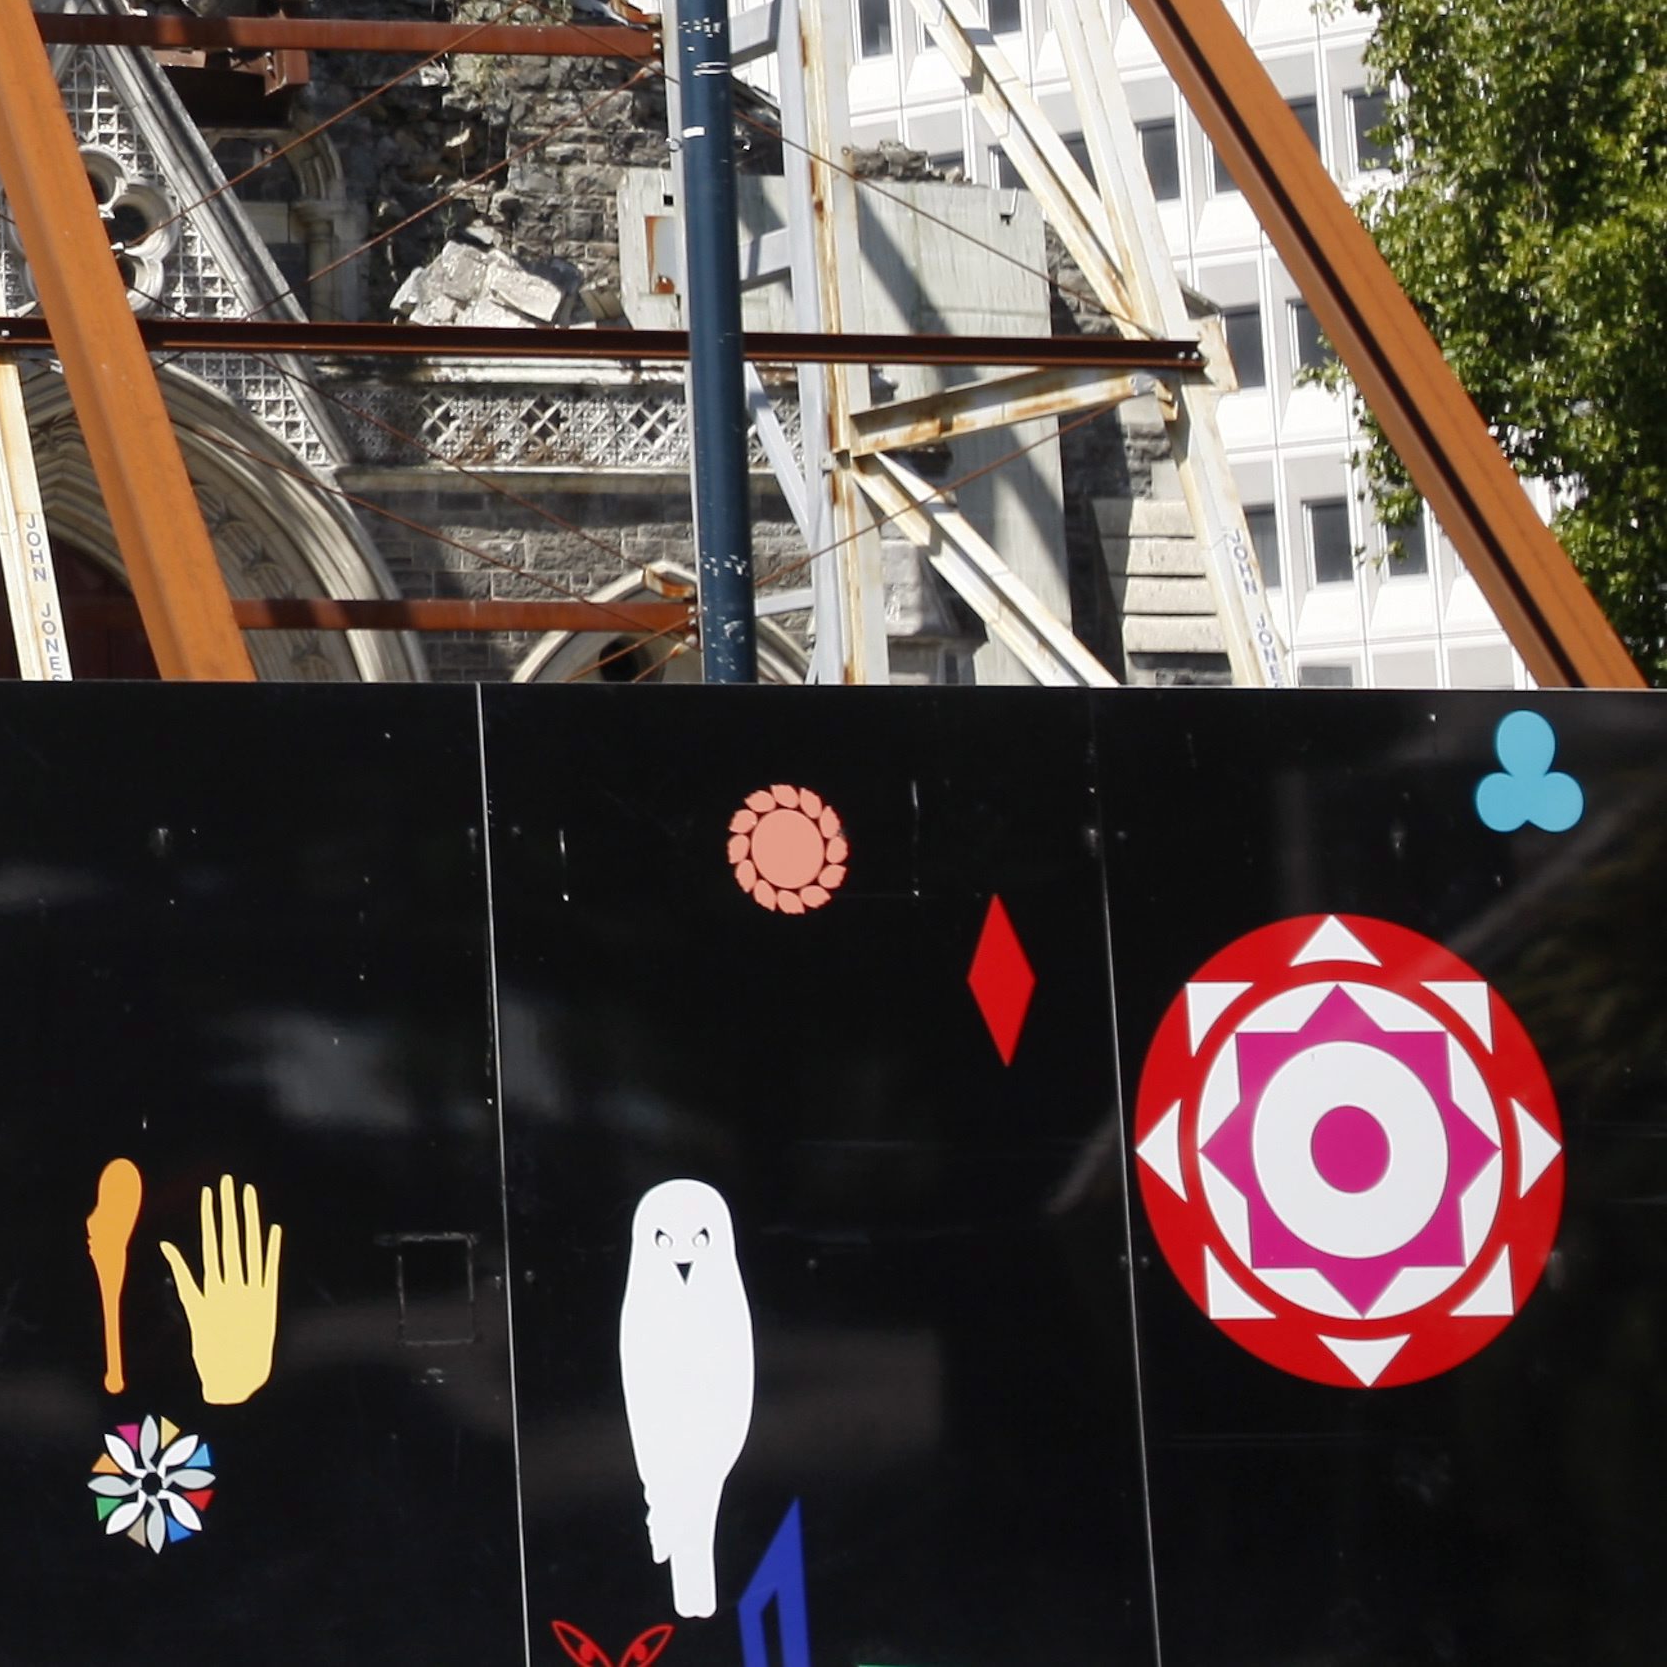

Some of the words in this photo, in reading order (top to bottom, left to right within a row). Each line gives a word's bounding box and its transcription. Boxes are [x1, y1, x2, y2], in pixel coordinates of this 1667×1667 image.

[26, 513, 48, 583] JOHN
[1230, 528, 1259, 596] JOHN
[1256, 612, 1285, 688] JONE
